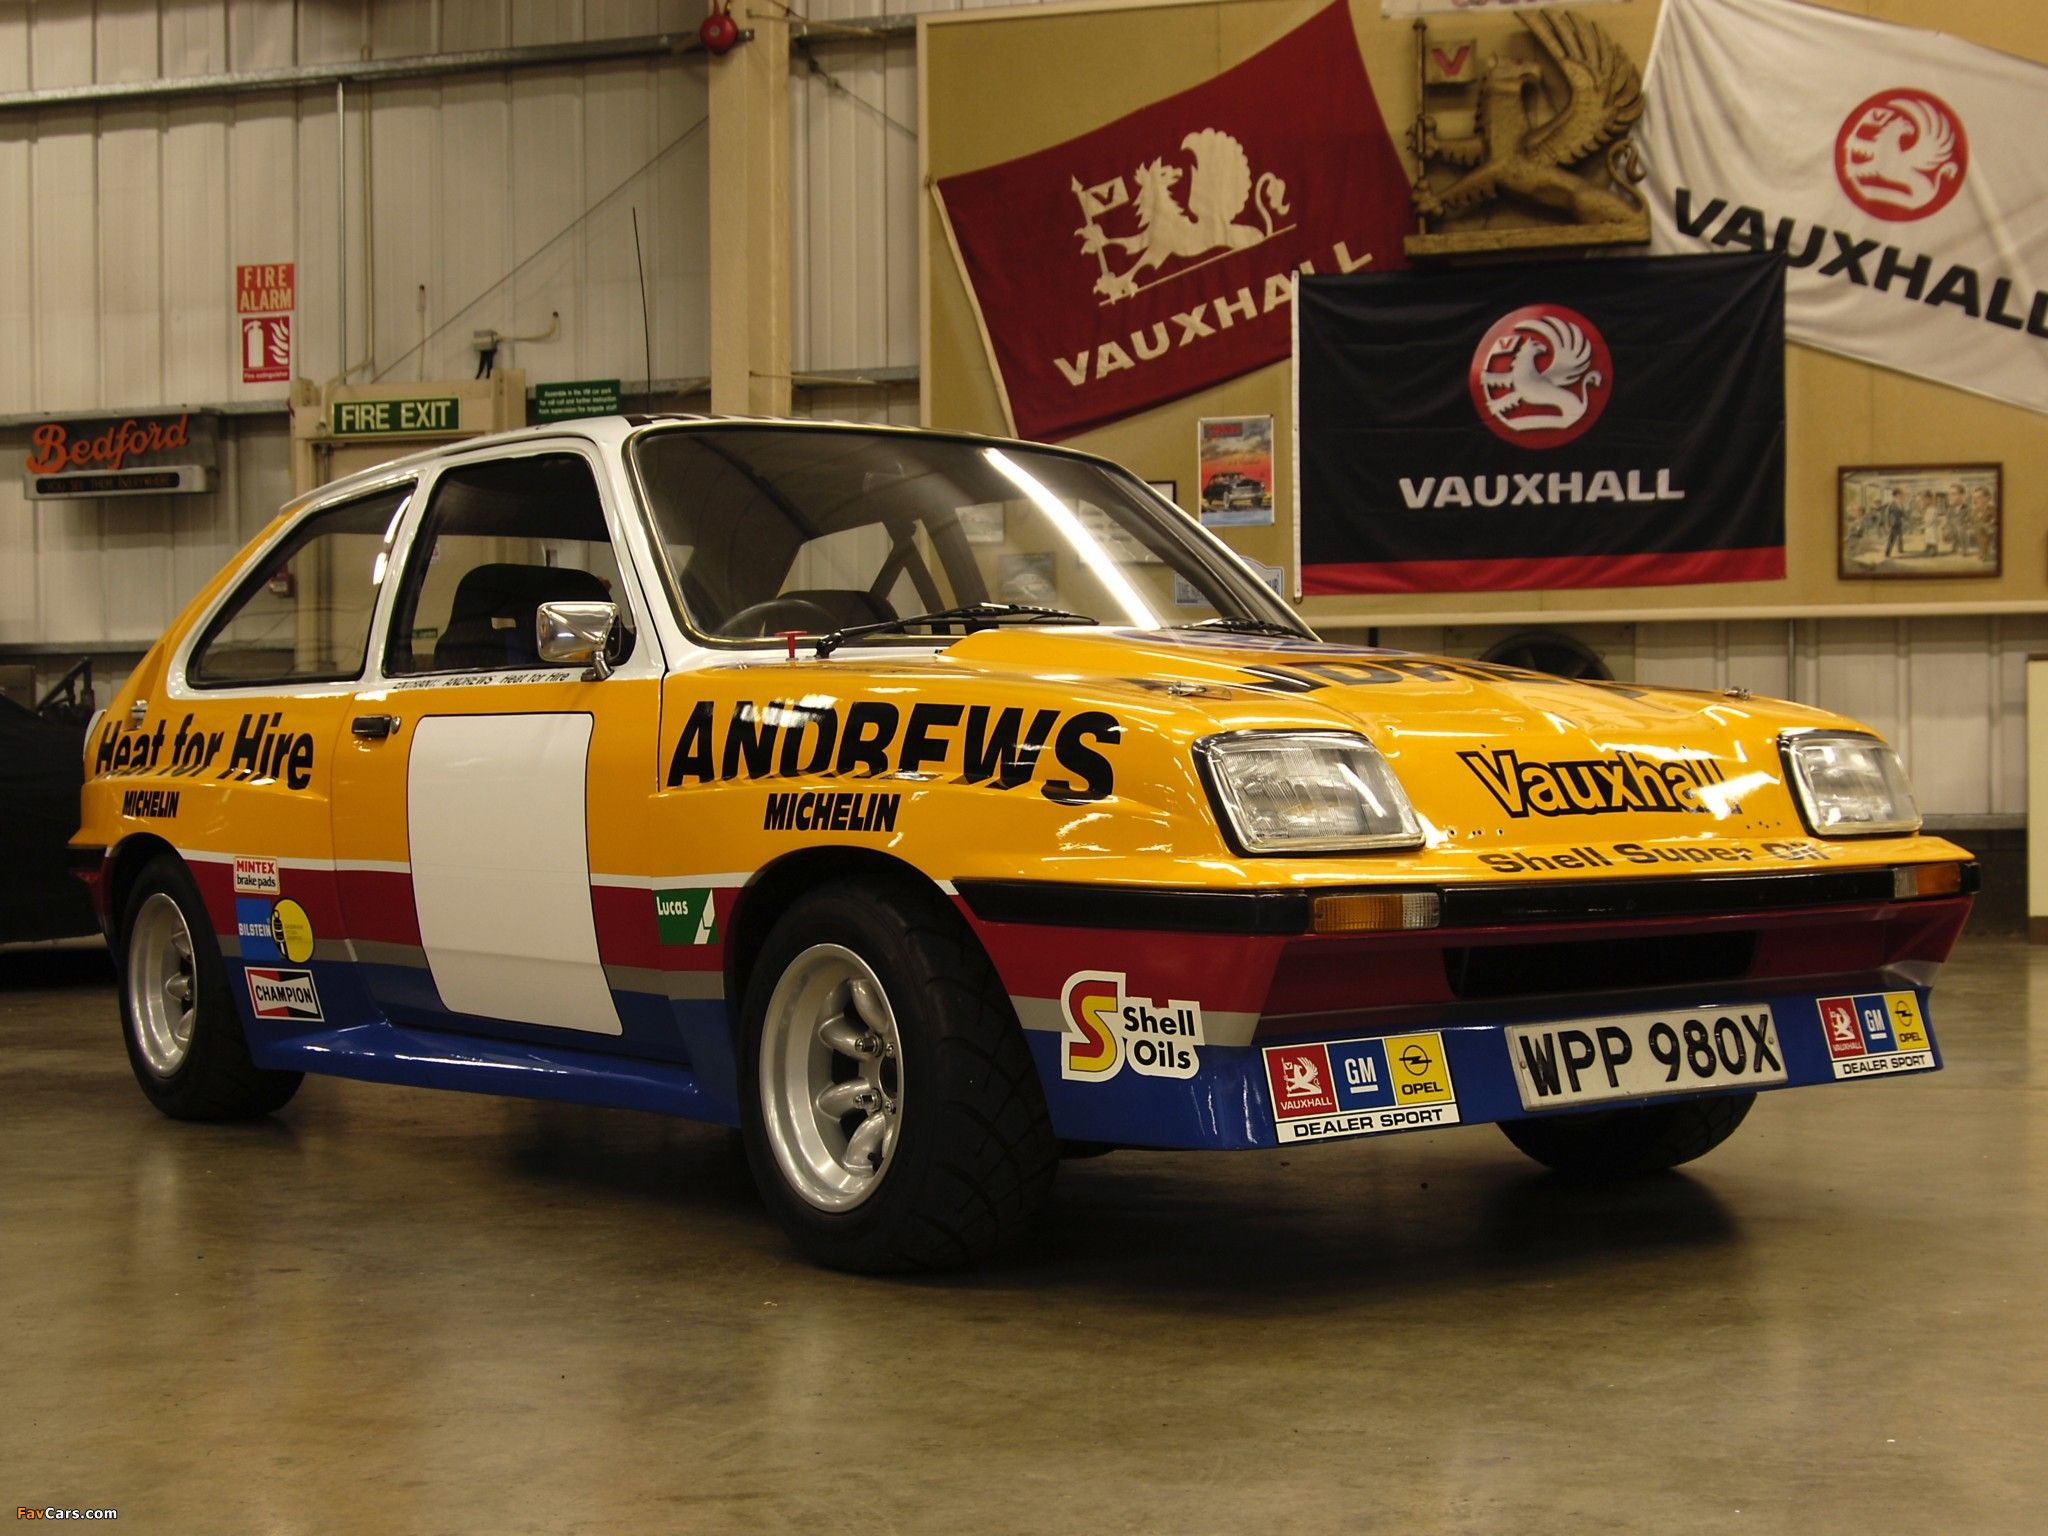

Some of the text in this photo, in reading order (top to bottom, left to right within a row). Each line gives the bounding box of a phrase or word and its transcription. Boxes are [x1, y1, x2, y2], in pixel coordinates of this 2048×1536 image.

[243, 266, 288, 289] FIRE
[240, 288, 292, 311] ALARM
[341, 400, 451, 431] FIRE EXIT
[26, 413, 189, 473] Bedford
[1399, 468, 1685, 509] VAUXHALL
[95, 711, 314, 790] Heat for Hire
[667, 699, 1122, 806] ANDREWS
[1456, 750, 1742, 819] Vauxhall
[122, 790, 180, 818] MICHELIN
[763, 792, 901, 832] MICHELIN
[236, 859, 275, 875] MINTEX
[1477, 845, 1613, 874] Shell
[1612, 842, 1752, 866] Super
[236, 874, 276, 889] brake pads
[656, 896, 689, 916] Lucas
[238, 922, 272, 937] BILSTEIN
[255, 985, 313, 1004] CHAMPION
[1122, 1005, 1196, 1036] Shell
[1864, 1008, 1886, 1033] GM
[1831, 1042, 1864, 1052] VAUXHALL
[1899, 1032, 1923, 1043] OPEL
[1133, 1040, 1192, 1070] Oils
[1518, 1013, 1782, 1098] WPP 980X
[1842, 1054, 1926, 1075] DEALER SPORT
[1344, 1056, 1378, 1085] GM
[1402, 1081, 1444, 1096] OPEL
[1280, 1096, 1333, 1111] VAUXHALL
[1293, 1108, 1444, 1138] DEALER SPORT
